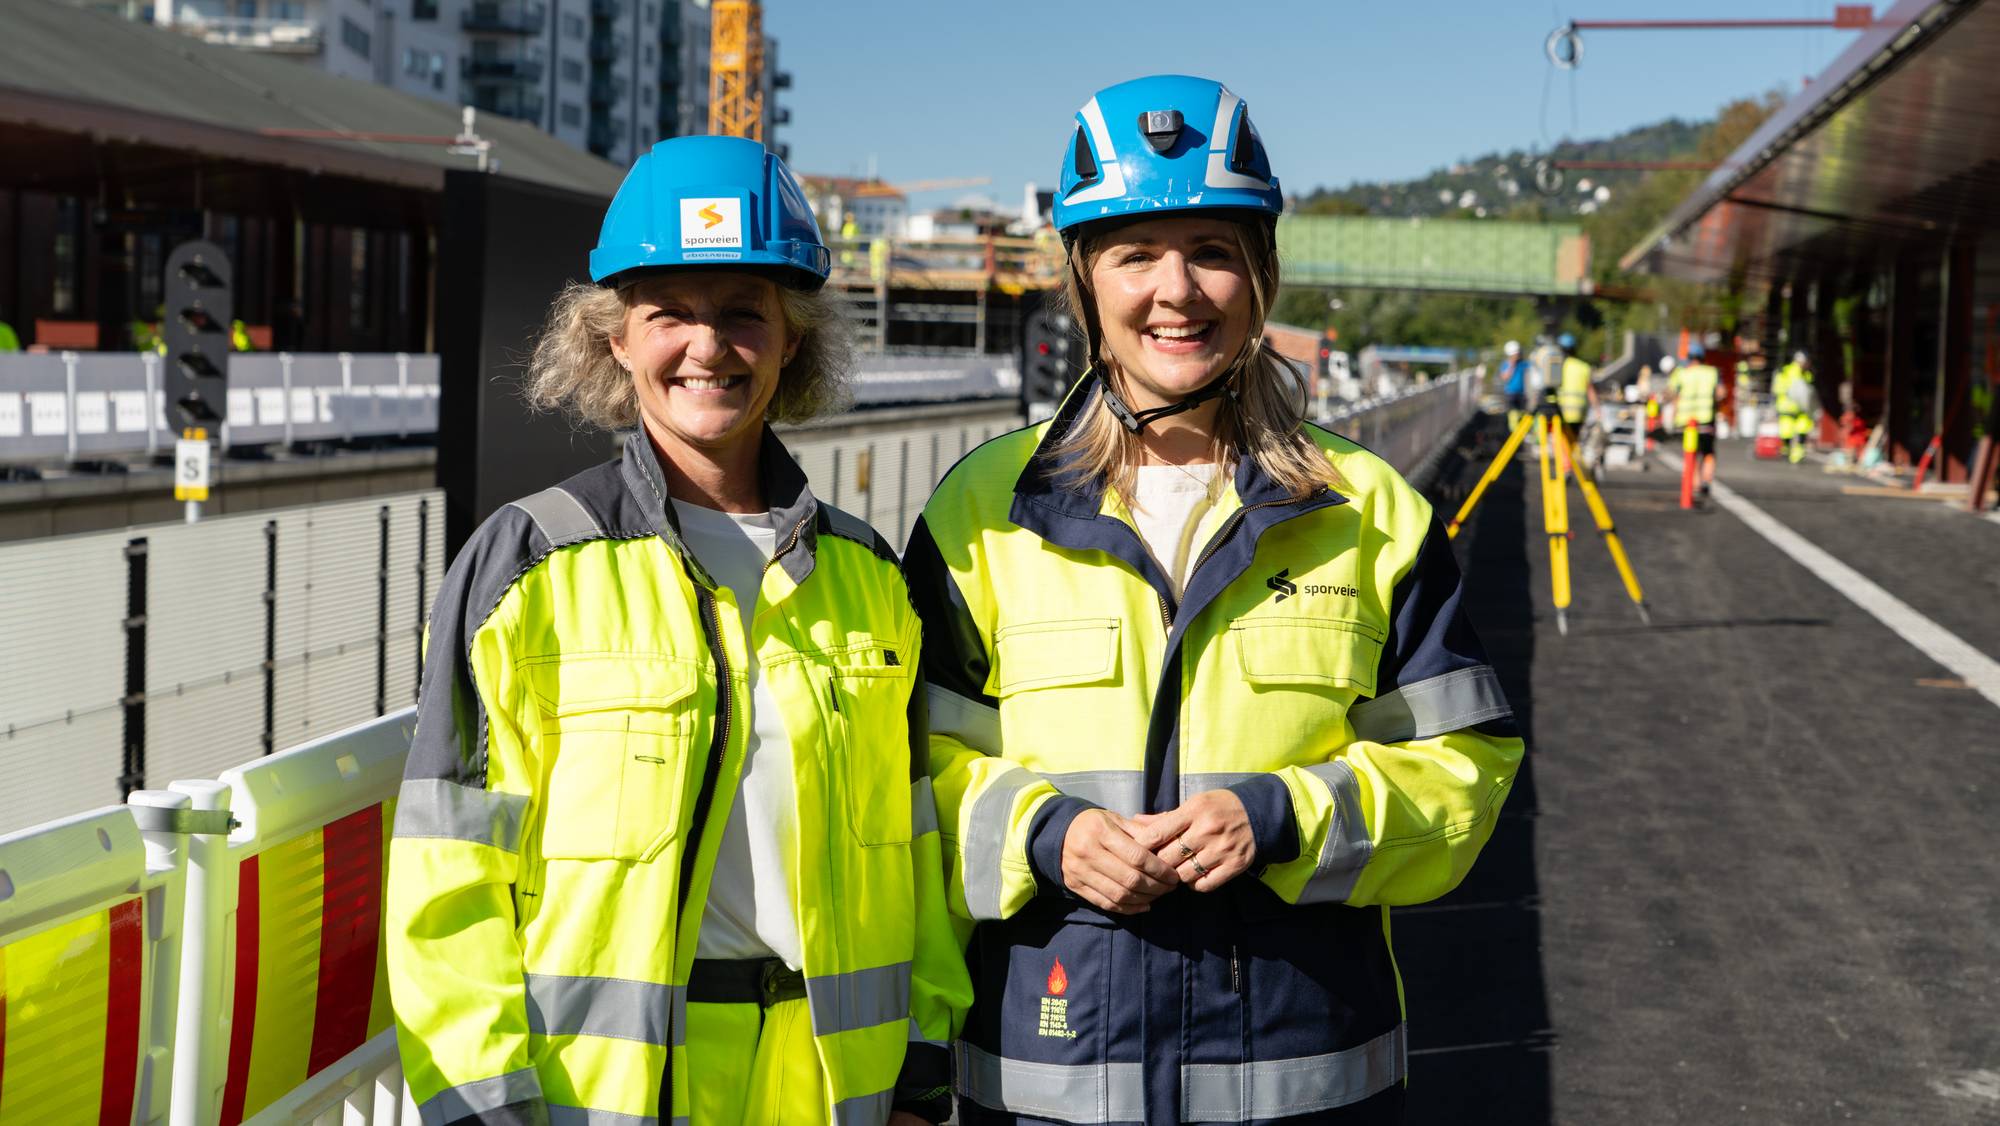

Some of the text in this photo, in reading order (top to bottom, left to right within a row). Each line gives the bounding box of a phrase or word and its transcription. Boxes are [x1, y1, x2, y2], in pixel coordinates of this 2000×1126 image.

[685, 235, 739, 246] sporveien
[184, 456, 200, 480] S
[1041, 997, 1051, 1006] EN
[1041, 1005, 1050, 1013] EN
[1040, 1020, 1049, 1028] EN
[1038, 1028, 1048, 1036] EN
